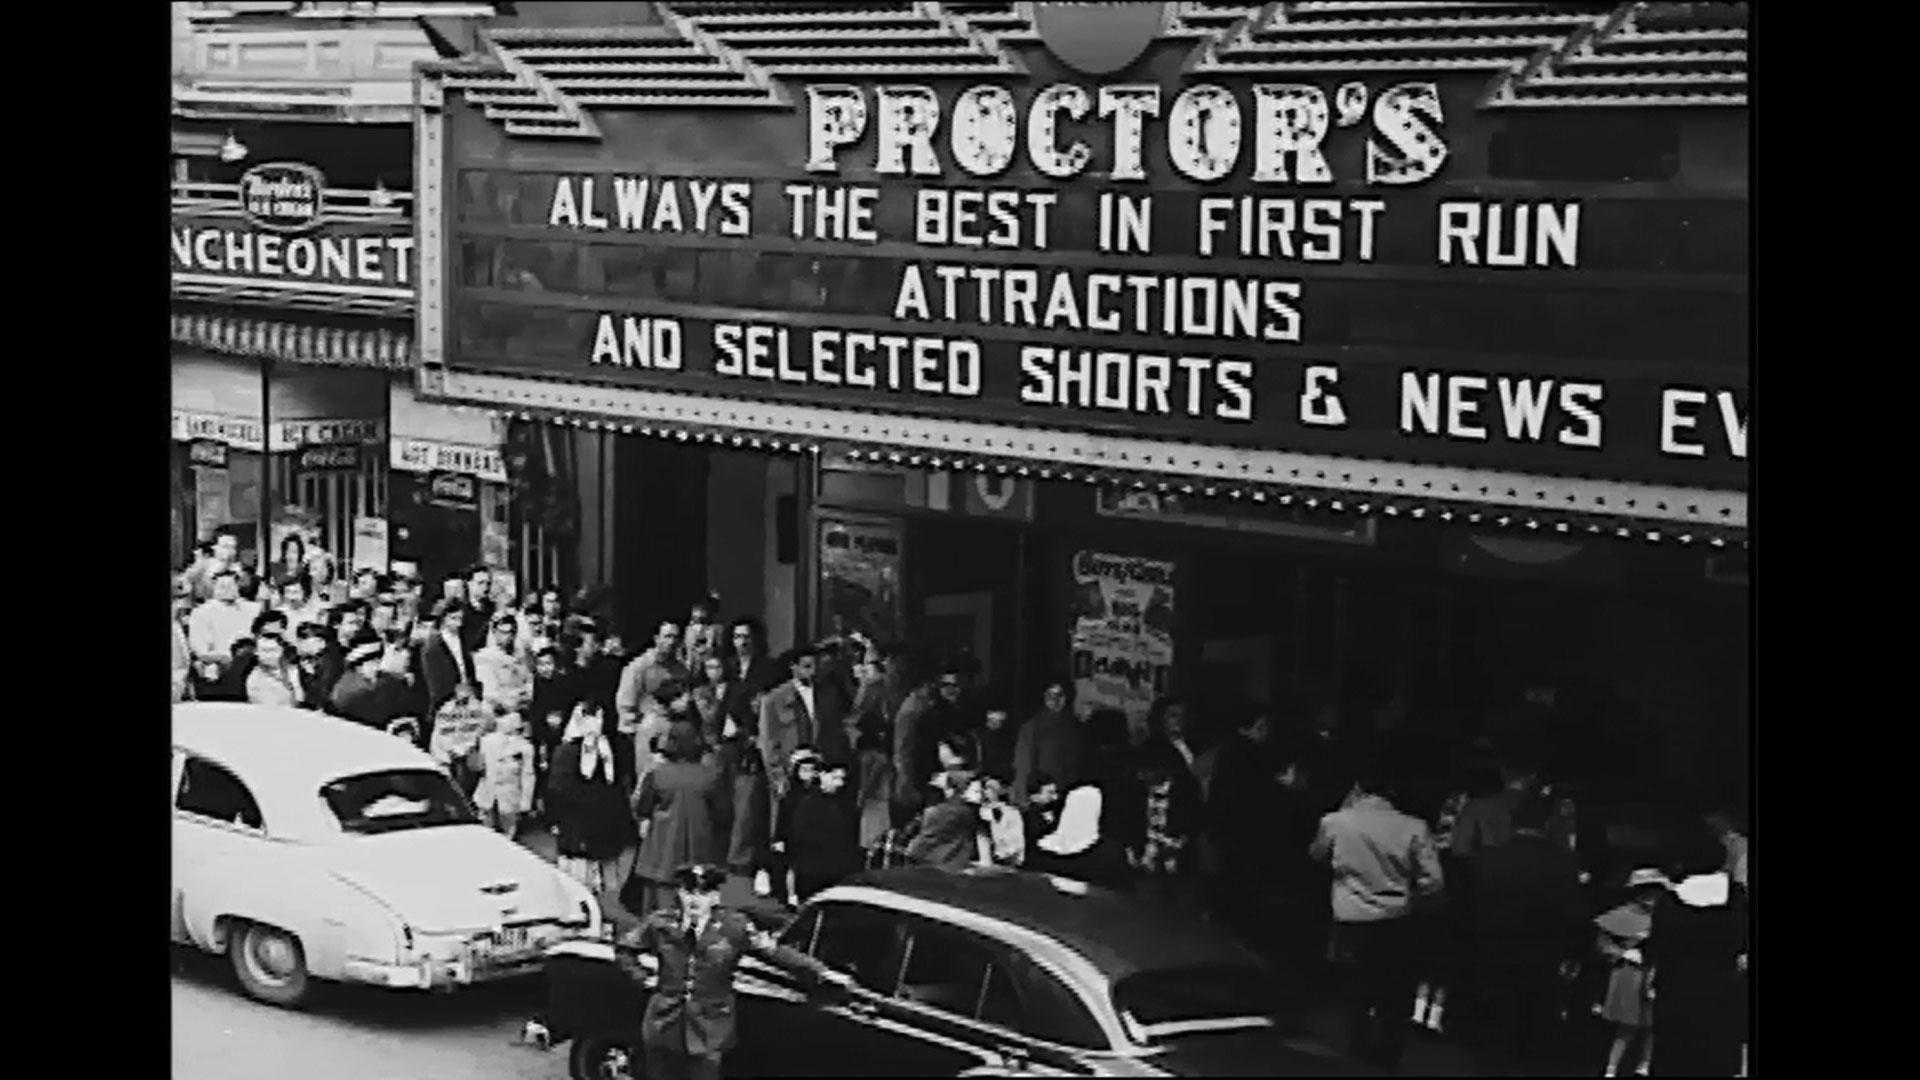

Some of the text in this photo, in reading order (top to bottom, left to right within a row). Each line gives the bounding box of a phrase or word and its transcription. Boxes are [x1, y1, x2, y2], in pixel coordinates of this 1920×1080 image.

[805, 83, 1447, 183] PROCTOR'S
[550, 177, 1578, 265] ALWAYS THE BEST IN FIRST RUN
[894, 265, 1299, 341] ATTRACTIONS
[593, 315, 680, 368] AND
[715, 325, 979, 394] SELECTED
[1022, 347, 1251, 419] SHORTS
[1302, 367, 1345, 424] &
[1402, 373, 1601, 446] NEWS
